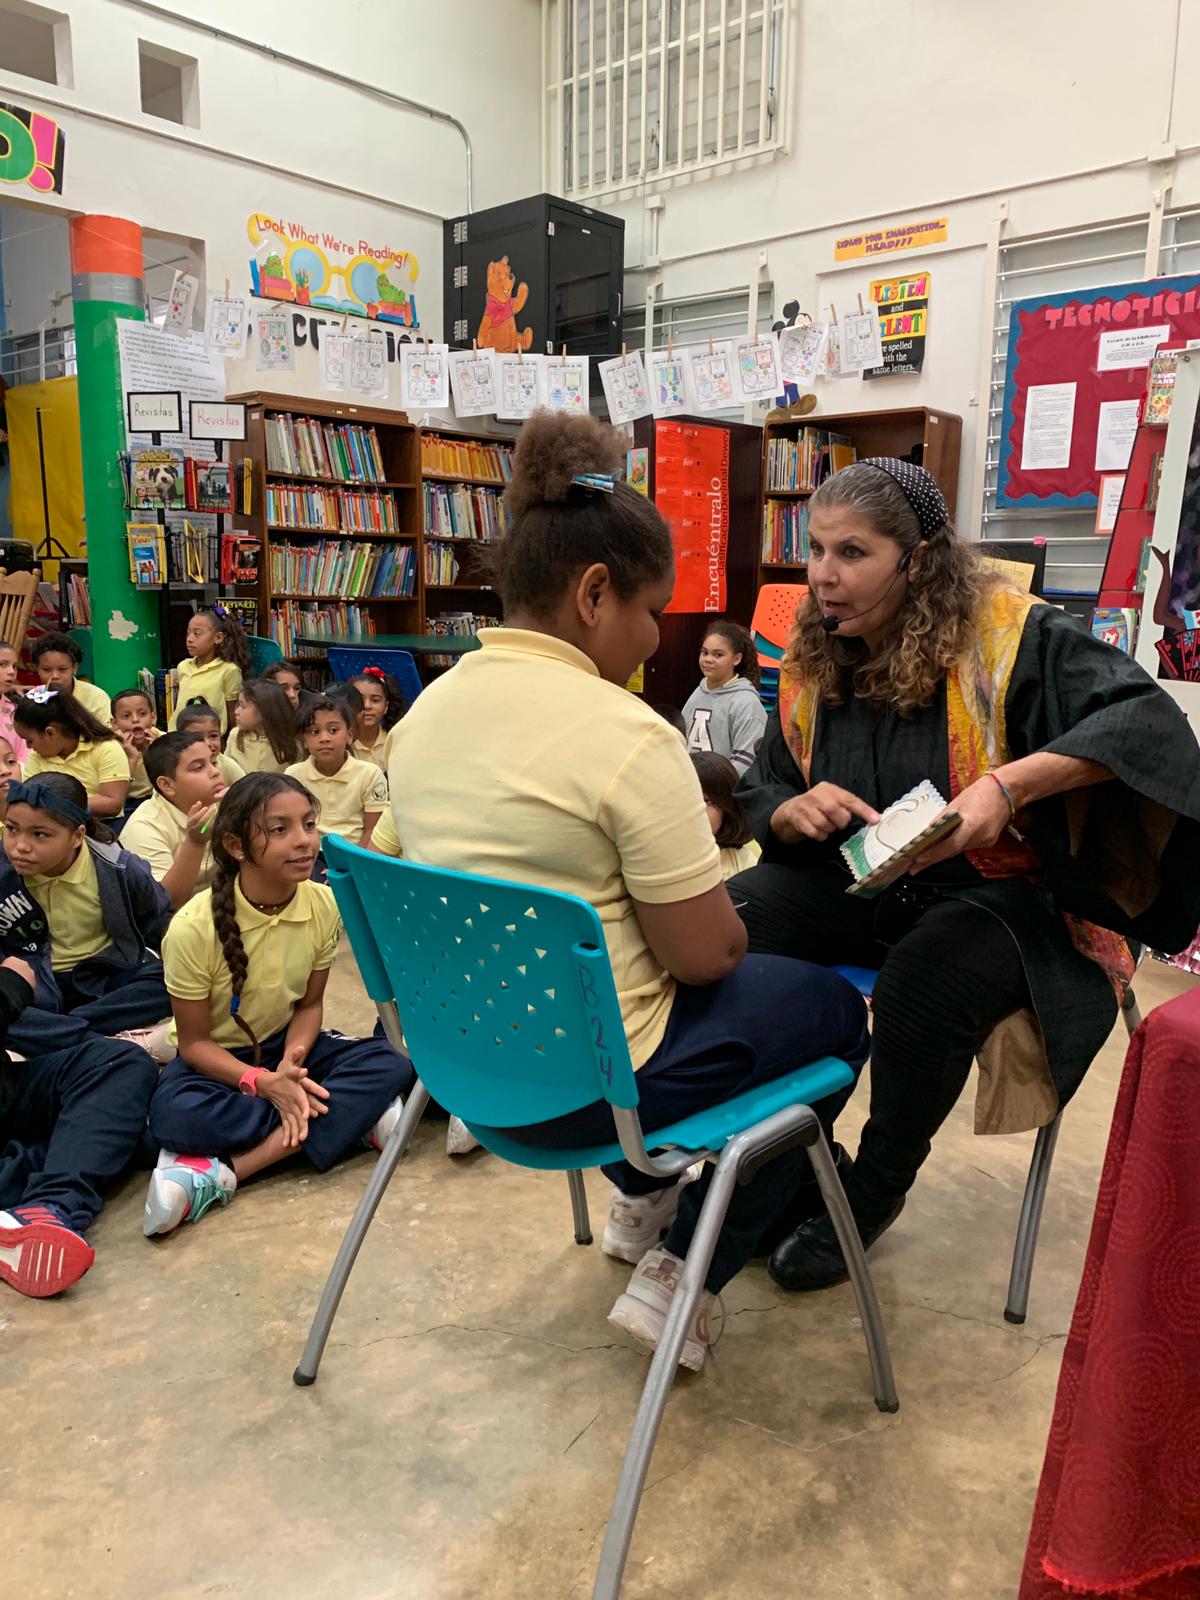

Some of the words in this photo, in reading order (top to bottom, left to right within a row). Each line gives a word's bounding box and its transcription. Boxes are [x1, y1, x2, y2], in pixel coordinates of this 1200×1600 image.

[255, 215, 285, 235] Look
[288, 222, 319, 245] What
[322, 233, 354, 255] We're
[358, 240, 408, 269] Reading!
[864, 232, 883, 243] YOUR
[874, 276, 928, 303] LISTEN
[891, 302, 904, 313] and
[1045, 290, 1200, 330] TECNOTICI
[880, 313, 923, 337] ILENT
[889, 340, 912, 353] spelled
[896, 351, 907, 361] the
[872, 366, 890, 374] same
[892, 361, 915, 373] letters.
[134, 400, 173, 417] Revistas
[197, 407, 240, 426] Revistas
[720, 431, 730, 466] Dewey
[721, 469, 729, 510] Decimal
[704, 477, 722, 612] Encuéntralo
[687, 708, 714, 752] A
[0, 890, 33, 937] OWN
[579, 962, 612, 1087] B24
